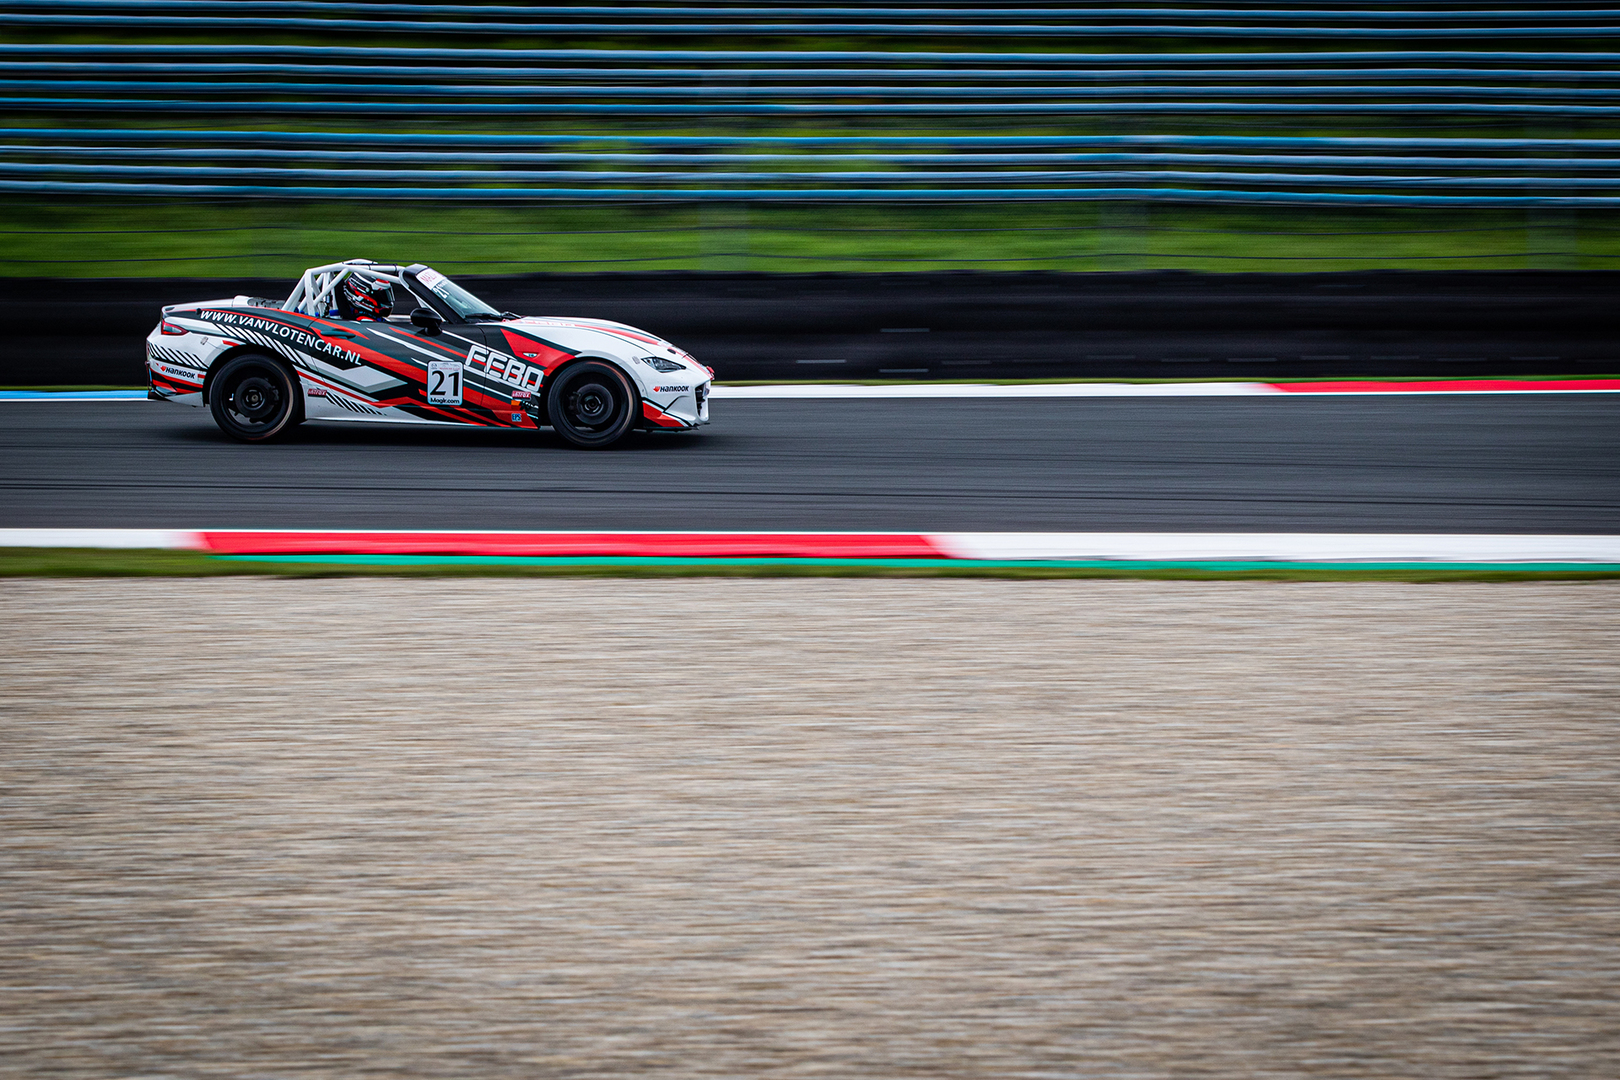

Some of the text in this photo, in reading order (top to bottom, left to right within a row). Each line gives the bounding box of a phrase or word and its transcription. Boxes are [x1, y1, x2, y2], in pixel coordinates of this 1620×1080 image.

[200, 310, 362, 366] WWW.VANVLOTENCAR.NL
[429, 369, 460, 397] 21
[465, 344, 544, 392] FEBO
